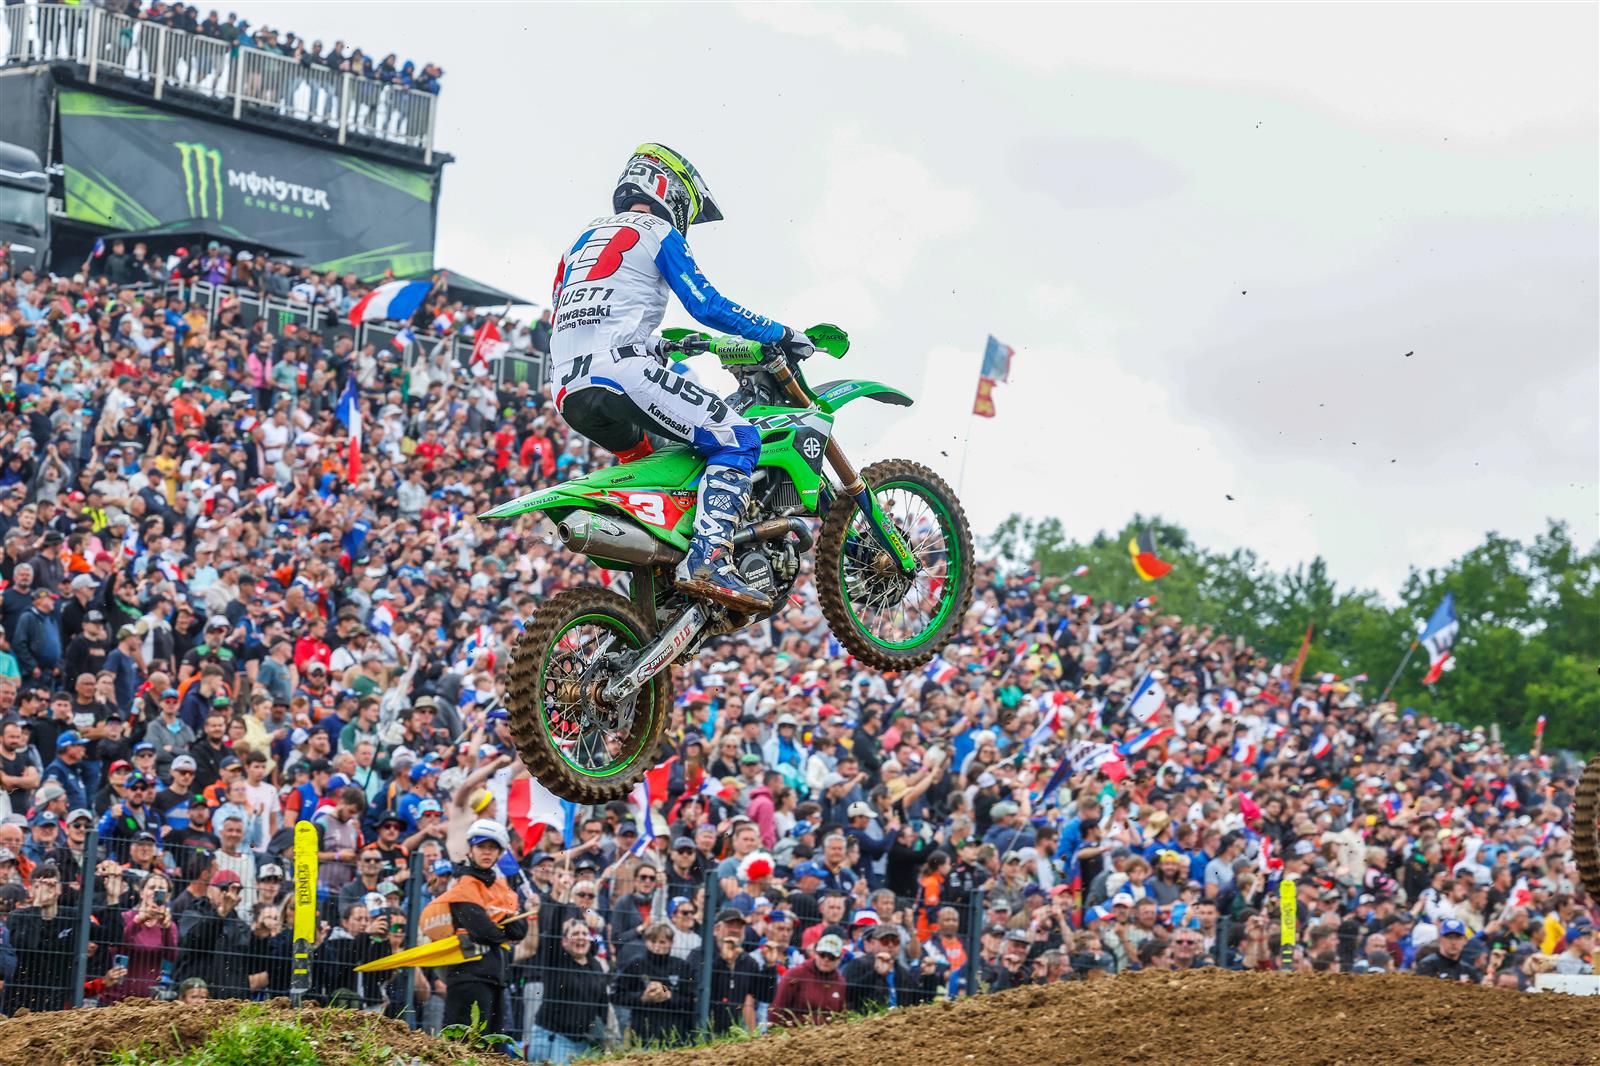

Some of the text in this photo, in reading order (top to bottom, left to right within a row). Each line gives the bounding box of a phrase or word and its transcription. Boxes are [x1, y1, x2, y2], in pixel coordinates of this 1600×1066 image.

[228, 168, 331, 211] MONSTER
[563, 225, 640, 288] 3
[557, 305, 611, 324] awasaki
[578, 317, 601, 326] Team
[647, 403, 692, 436] Kawasaki
[610, 473, 636, 484] Kawasaki
[523, 495, 560, 508] DUNLOP
[628, 493, 666, 526] 3
